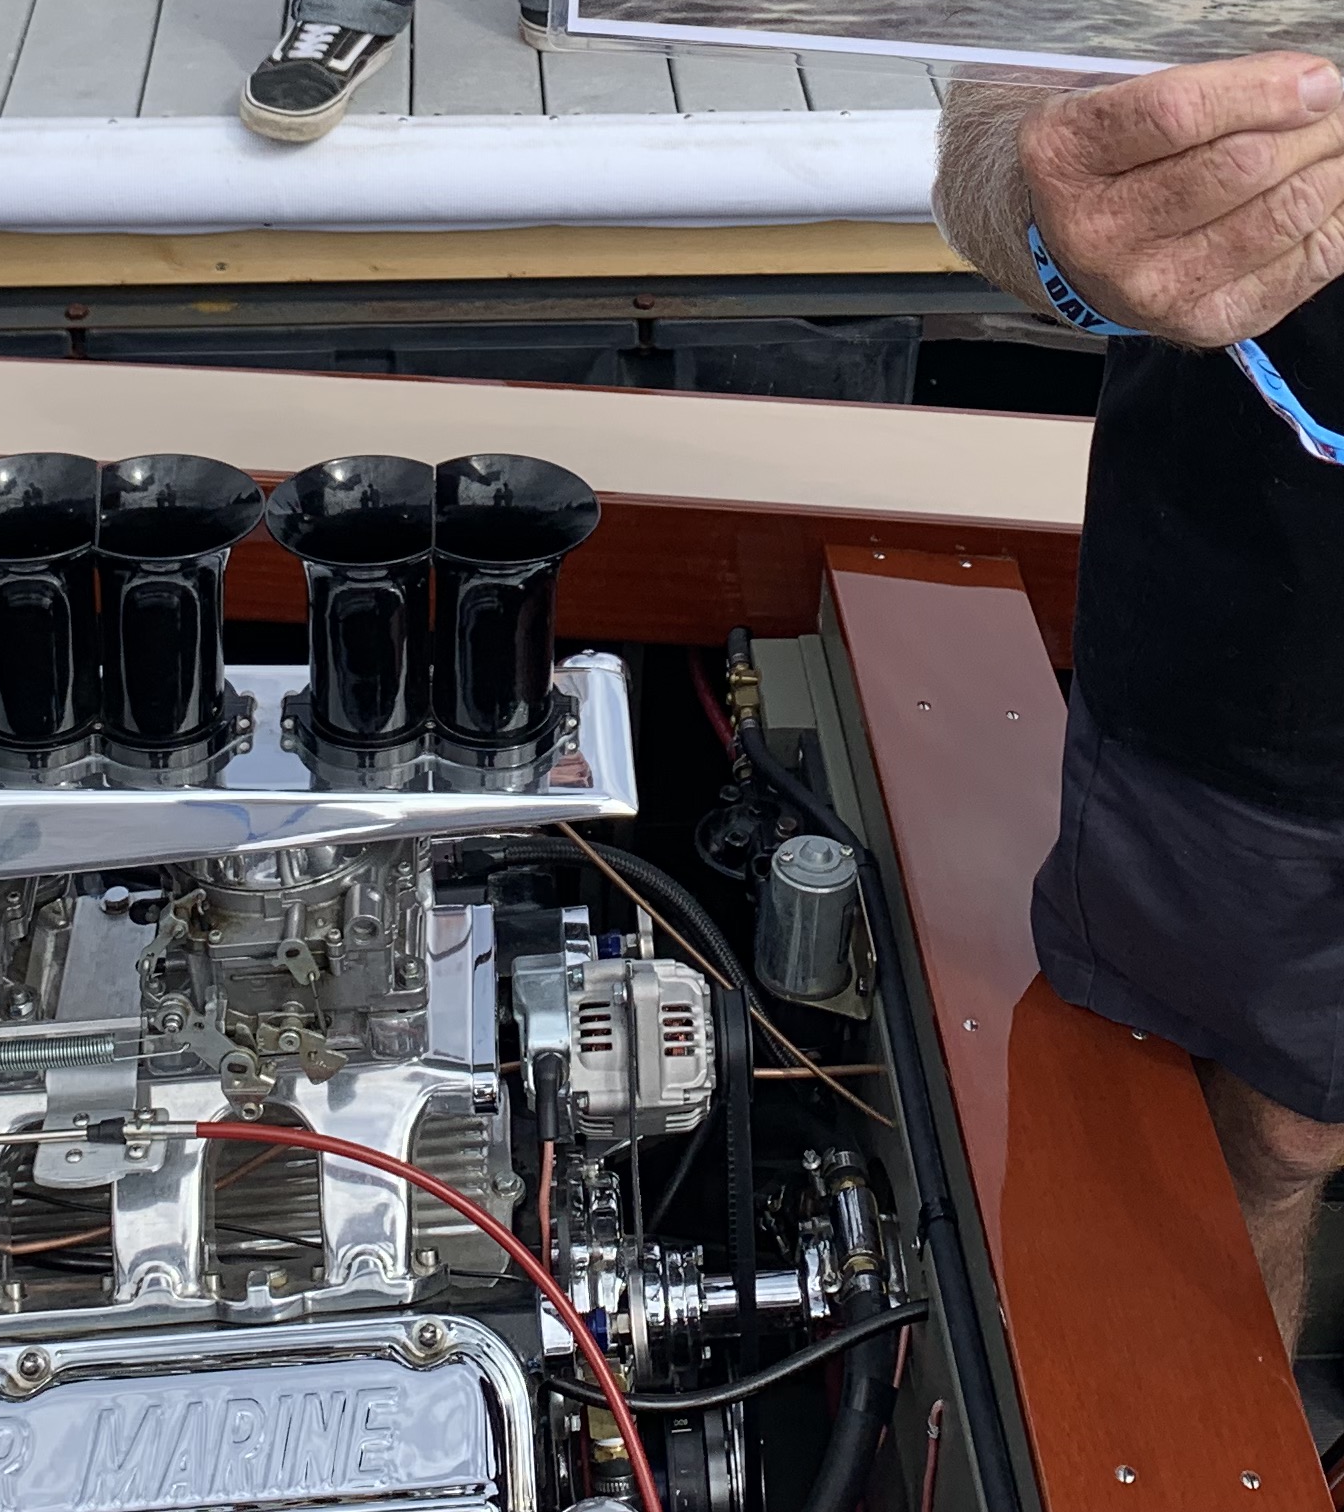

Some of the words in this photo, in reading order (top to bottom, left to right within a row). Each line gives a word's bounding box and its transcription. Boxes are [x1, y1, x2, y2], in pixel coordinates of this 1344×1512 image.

[1033, 246, 1048, 271] 2
[1044, 275, 1107, 328] DAY
[74, 1385, 402, 1509] MARINE
